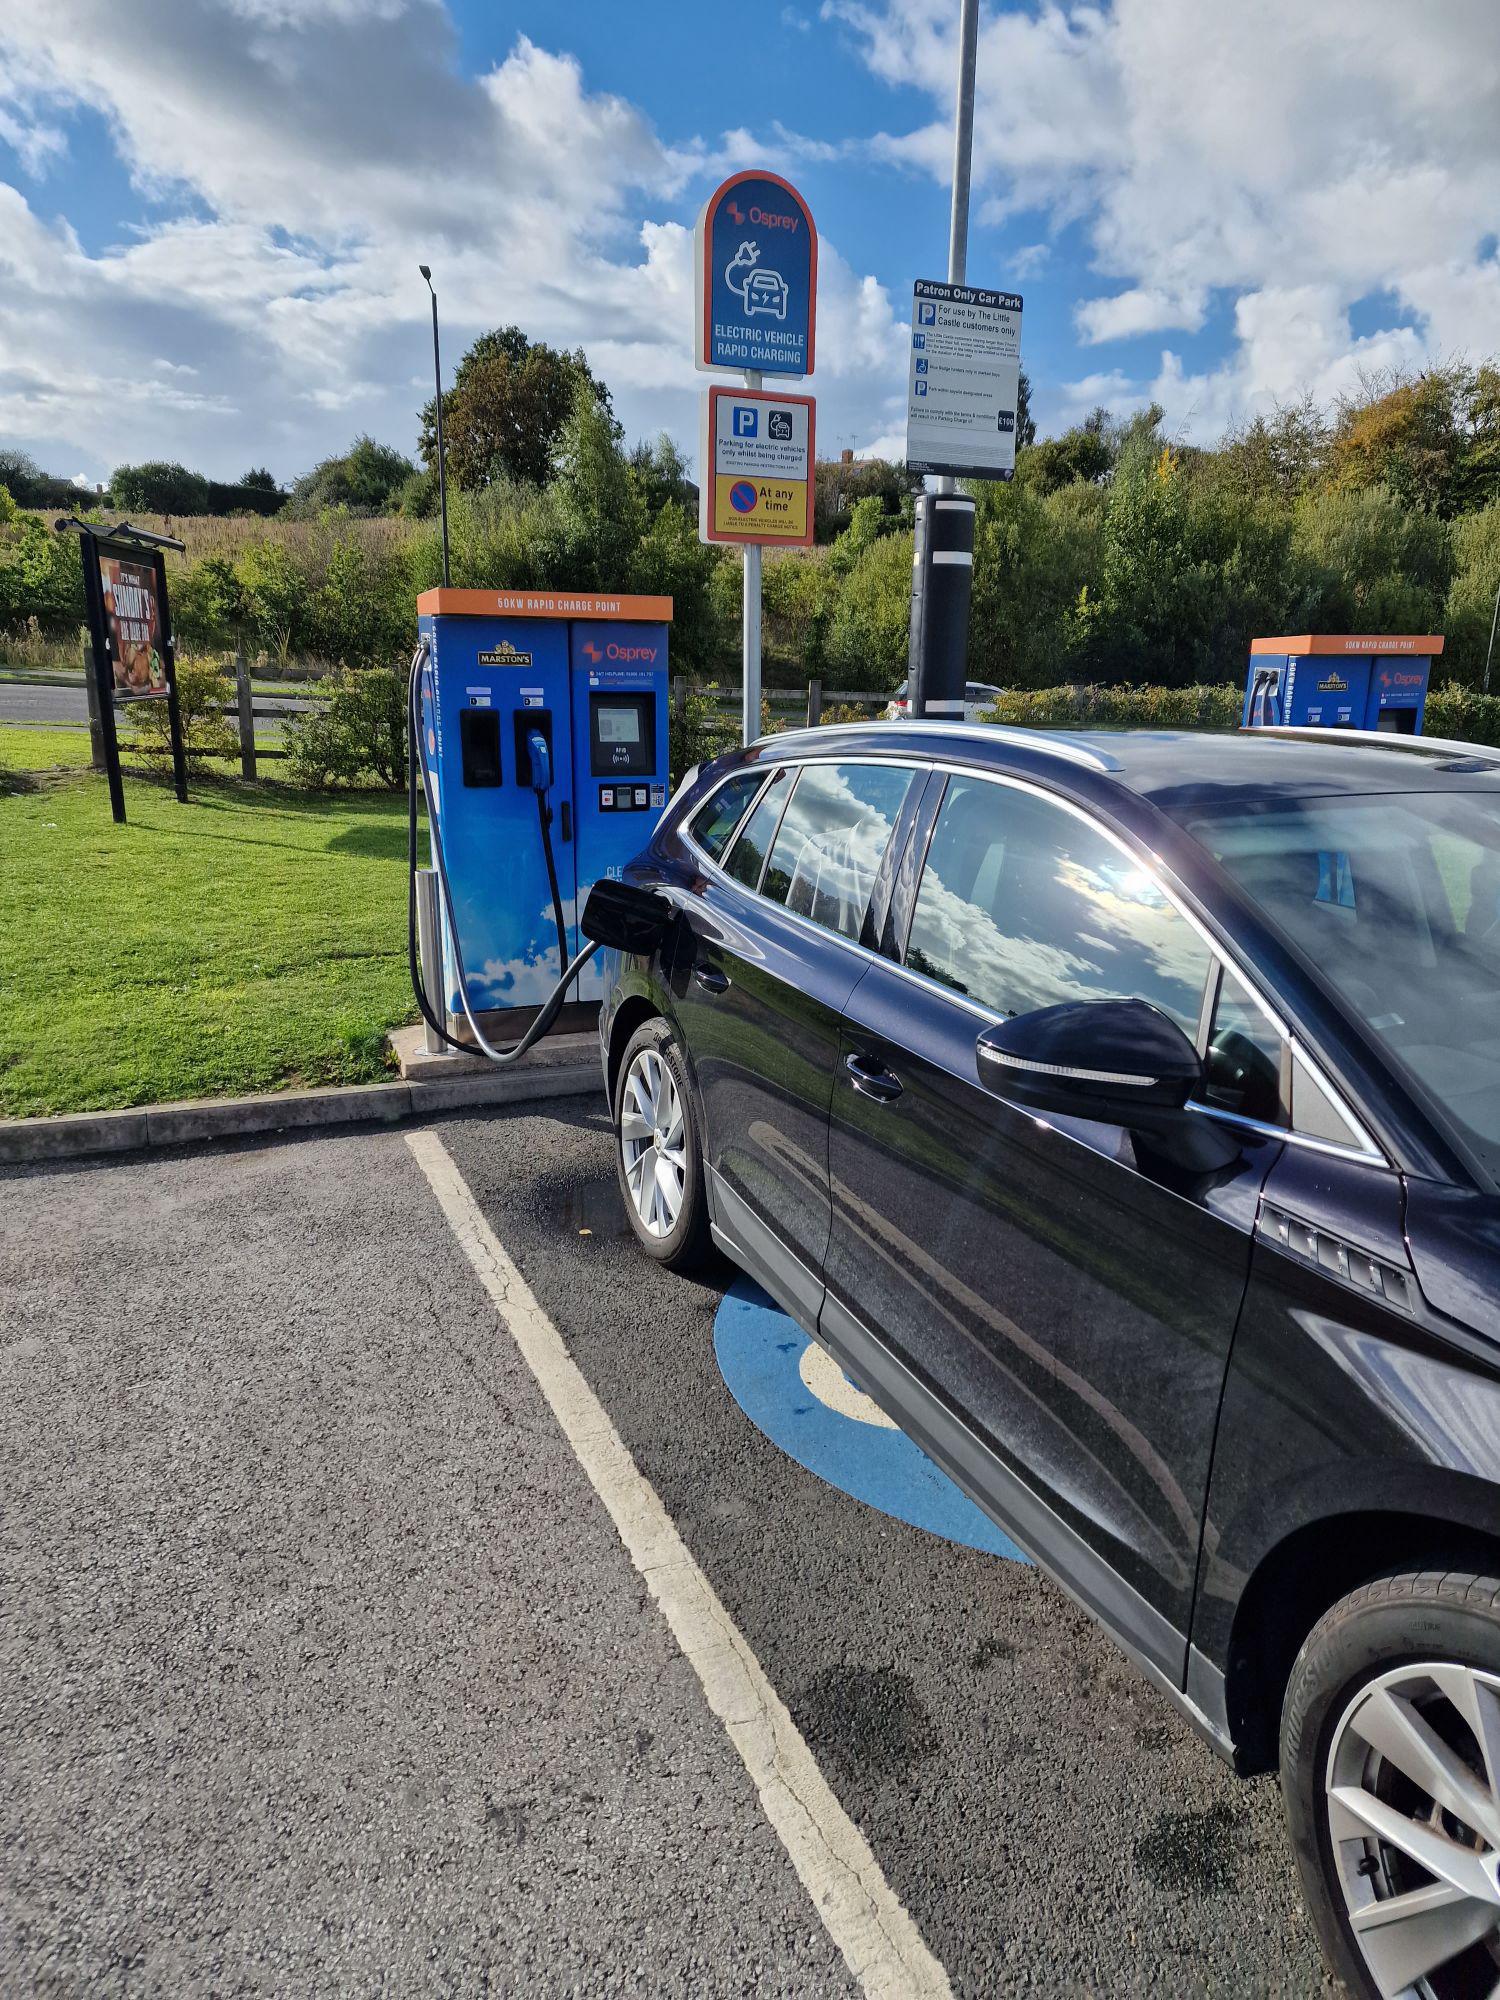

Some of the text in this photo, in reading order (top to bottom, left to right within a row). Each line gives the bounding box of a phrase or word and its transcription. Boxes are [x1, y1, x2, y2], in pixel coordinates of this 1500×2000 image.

[750, 207, 798, 233] Osprey
[916, 282, 1020, 308] Patron Only Car Park
[939, 304, 1010, 323] For use by The Little
[715, 324, 804, 346] ELECTRIC VEHICLE
[938, 317, 1015, 338] Castle customers only
[718, 342, 800, 363] RAPID CHARGING
[719, 439, 743, 448] Parking
[777, 453, 802, 462] charged
[760, 487, 793, 500] At any
[766, 501, 788, 511] time
[129, 574, 140, 585] WHAT
[112, 584, 150, 620] SUNDAY'S
[498, 598, 620, 612] 50KW RAPID CHARGE POINT
[606, 643, 657, 663] Osprey
[1394, 672, 1423, 686] Osprey
[1286, 686, 1294, 707] RAPID
[607, 866, 622, 878] CLE
